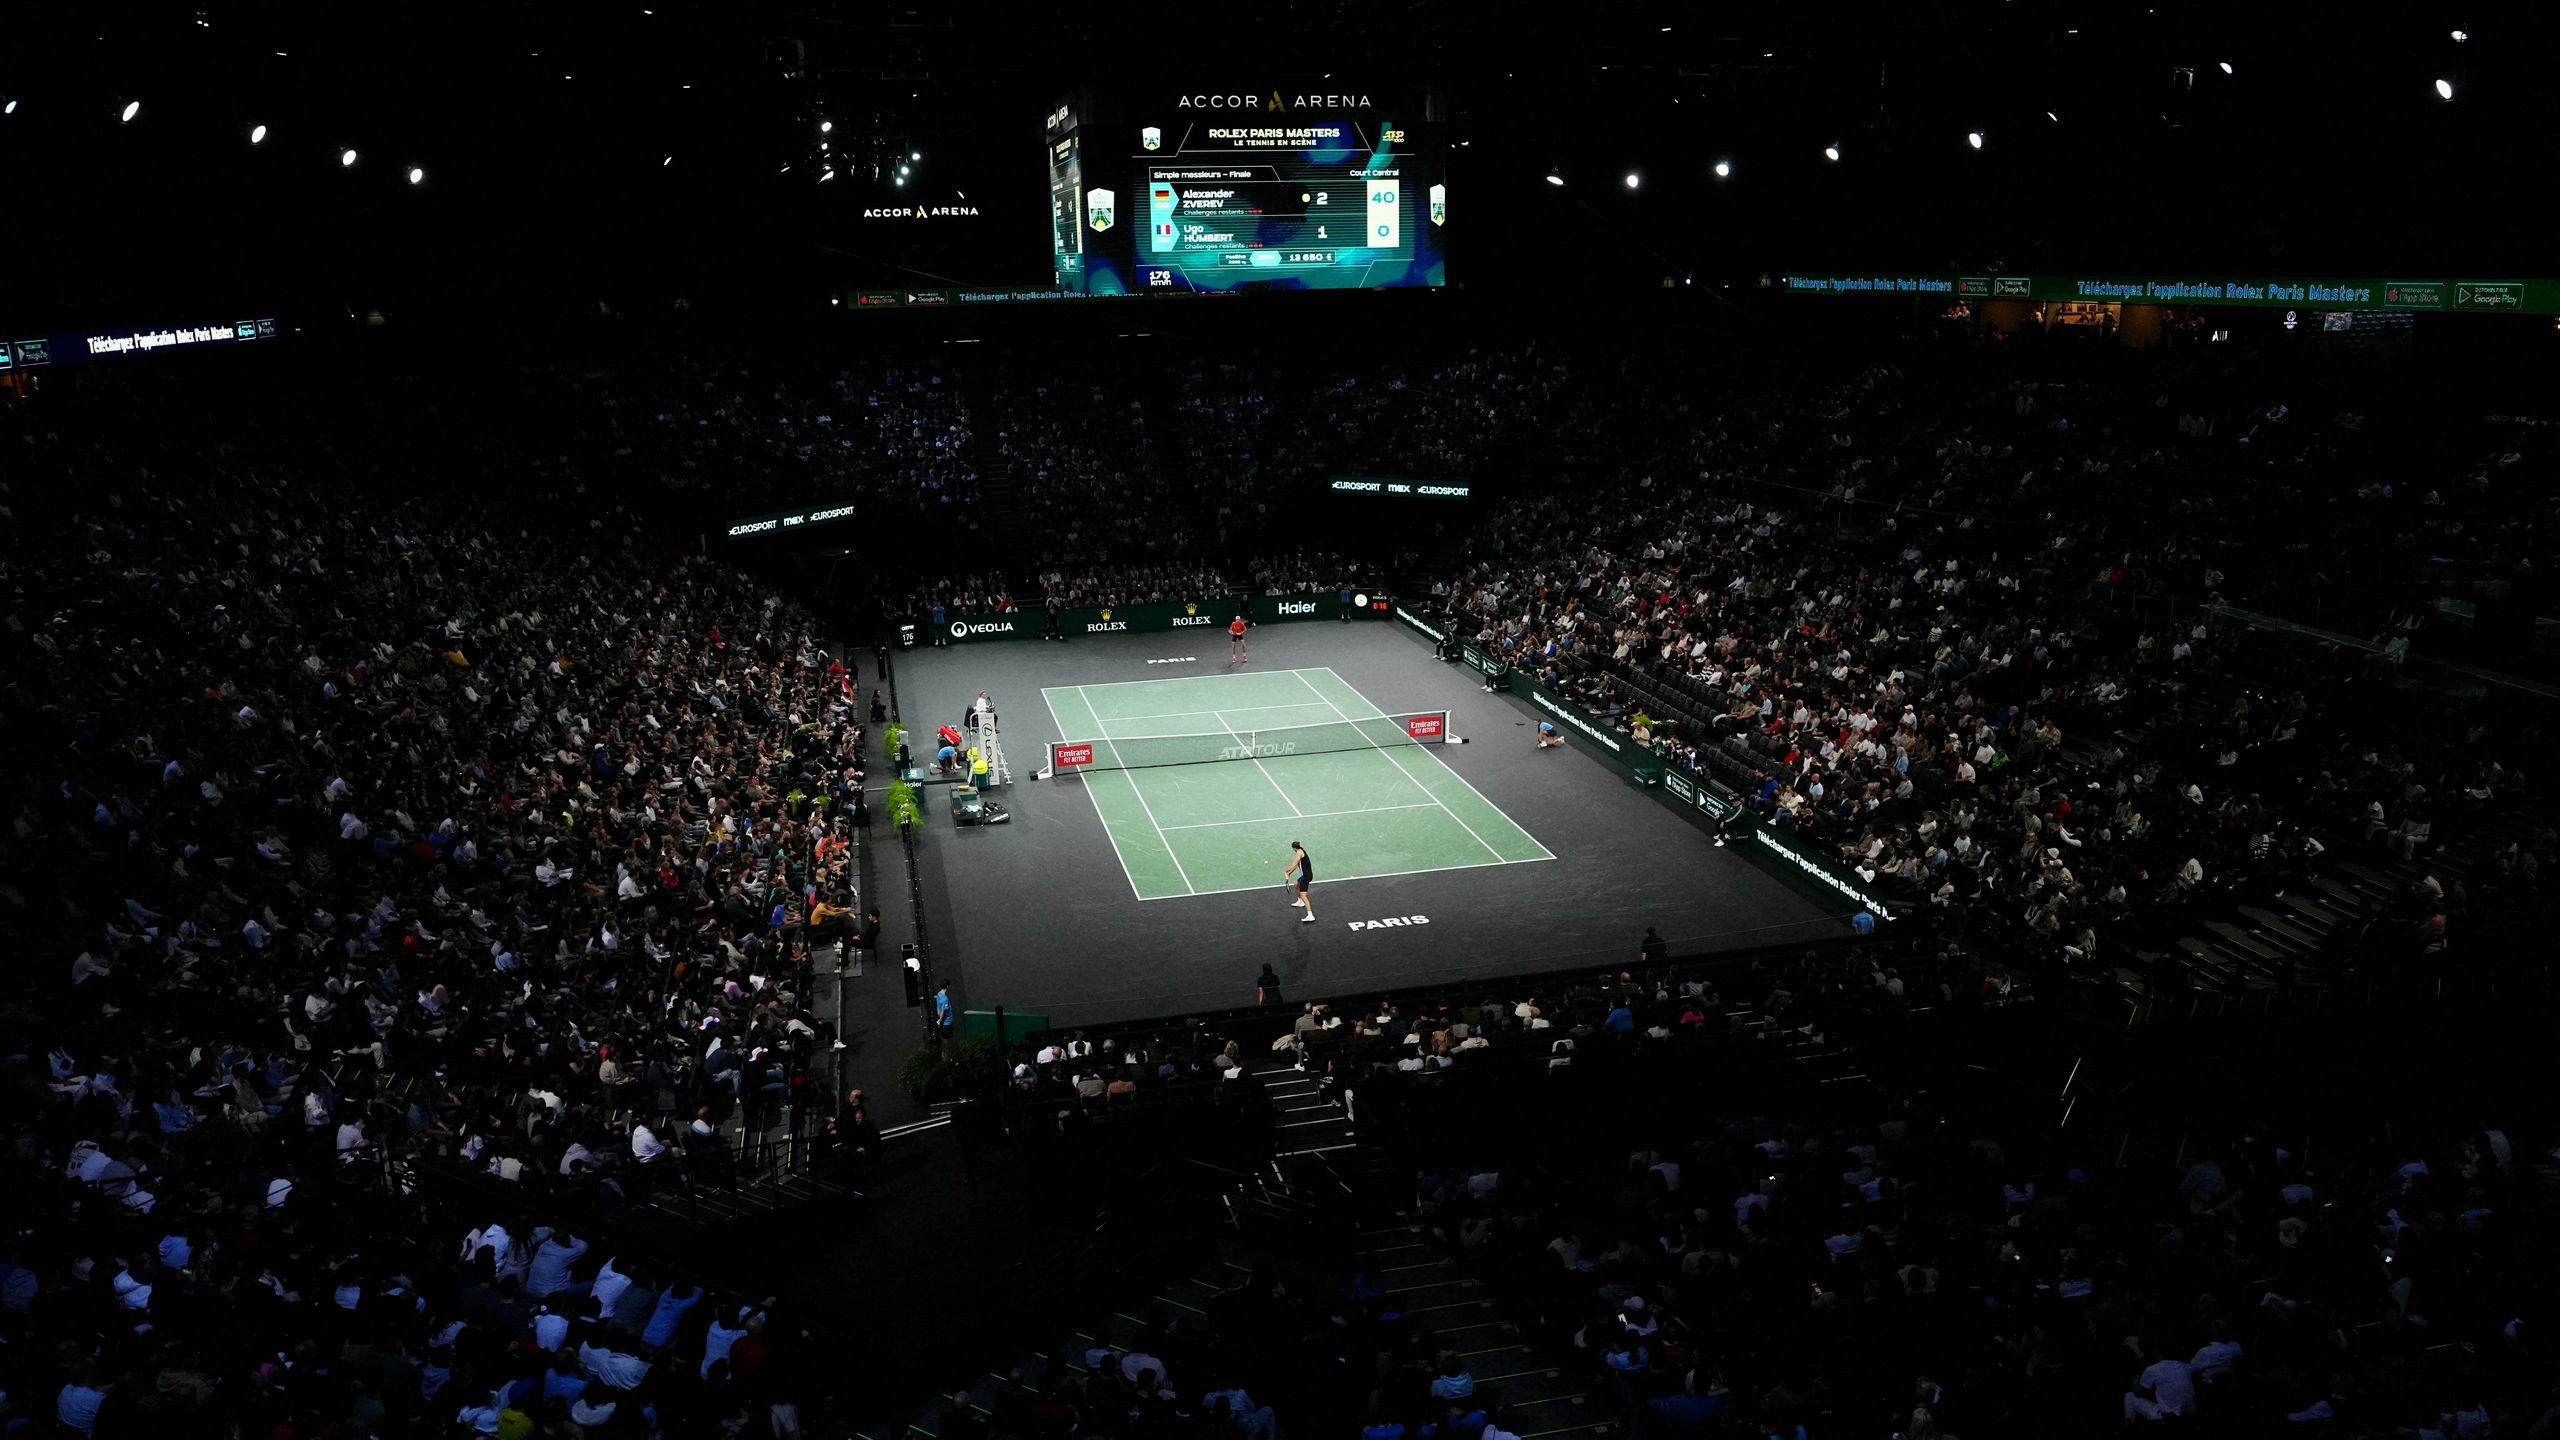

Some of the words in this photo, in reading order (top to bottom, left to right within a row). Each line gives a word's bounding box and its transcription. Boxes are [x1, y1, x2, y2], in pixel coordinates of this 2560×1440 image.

[1178, 95, 1258, 108] ACCOR
[1294, 95, 1371, 108] ARENA
[1209, 128, 1248, 138] ROLEX
[1250, 128, 1283, 138] PARIS
[1286, 128, 1340, 138] MASTERS
[1382, 130, 1404, 140] ATP
[1290, 137, 1317, 146] SCÈNE
[1153, 171, 1180, 180] Simple
[1181, 170, 1222, 179] messieurs
[1229, 170, 1251, 178] Finale
[1349, 169, 1371, 177] Court
[1373, 169, 1399, 177] Central
[1183, 189, 1234, 199] Alexander
[1316, 192, 1328, 205] 2
[1371, 191, 1395, 204] 40
[1183, 199, 1224, 208] ZVEREV
[863, 208, 912, 218] ACCOR
[931, 206, 979, 216] ARENA
[1183, 224, 1204, 235] Ugo
[1317, 225, 1328, 238] 1
[1377, 225, 1390, 237] 0
[1184, 233, 1234, 242] HUMBERT
[1326, 253, 1333, 261] €
[1150, 271, 1171, 280] 176
[1151, 278, 1172, 286] km/h
[1788, 276, 1828, 291] Téléchargez
[1873, 278, 1895, 291] Rolex
[1897, 278, 1917, 291] Paris
[1919, 278, 1952, 292] Masters
[958, 291, 1009, 302] Téléchargez
[1010, 291, 1062, 302] l'application
[2077, 281, 2143, 298] Téléchargez
[2146, 282, 2222, 300] l'application
[2226, 283, 2263, 300] Rolex
[2268, 284, 2304, 300] Paris
[2308, 284, 2371, 301] Masters
[2473, 294, 2501, 306] Google
[2501, 294, 2517, 305] Play
[86, 335, 135, 354] Téléchargez
[175, 328, 195, 344] Rolex
[194, 326, 211, 342] Paris
[210, 325, 234, 341] Masters
[1332, 481, 1381, 491] EUROSPORT
[1388, 484, 1410, 493] max
[1418, 486, 1469, 496] EUROSPORT
[730, 519, 777, 535] EUROSPORT
[783, 515, 804, 527] max
[811, 506, 854, 521] EUROSPORT
[1278, 600, 1316, 614] Haier
[1172, 615, 1212, 626] ROLEX
[968, 622, 1014, 634] VEOLIA
[1087, 621, 1127, 632] ROLEX
[902, 632, 914, 641] 176
[1146, 656, 1197, 664] PARIS
[1410, 720, 1440, 729] Emirates
[1058, 749, 1091, 758] Emirates
[1255, 742, 1296, 757] TOUR
[903, 780, 922, 788] Haier
[1756, 829, 1796, 862] Téléchargez
[1795, 852, 1839, 889] l'application
[1839, 880, 1860, 901] Rolex
[1861, 893, 1881, 914] Paris
[1347, 914, 1430, 931] PARIS
